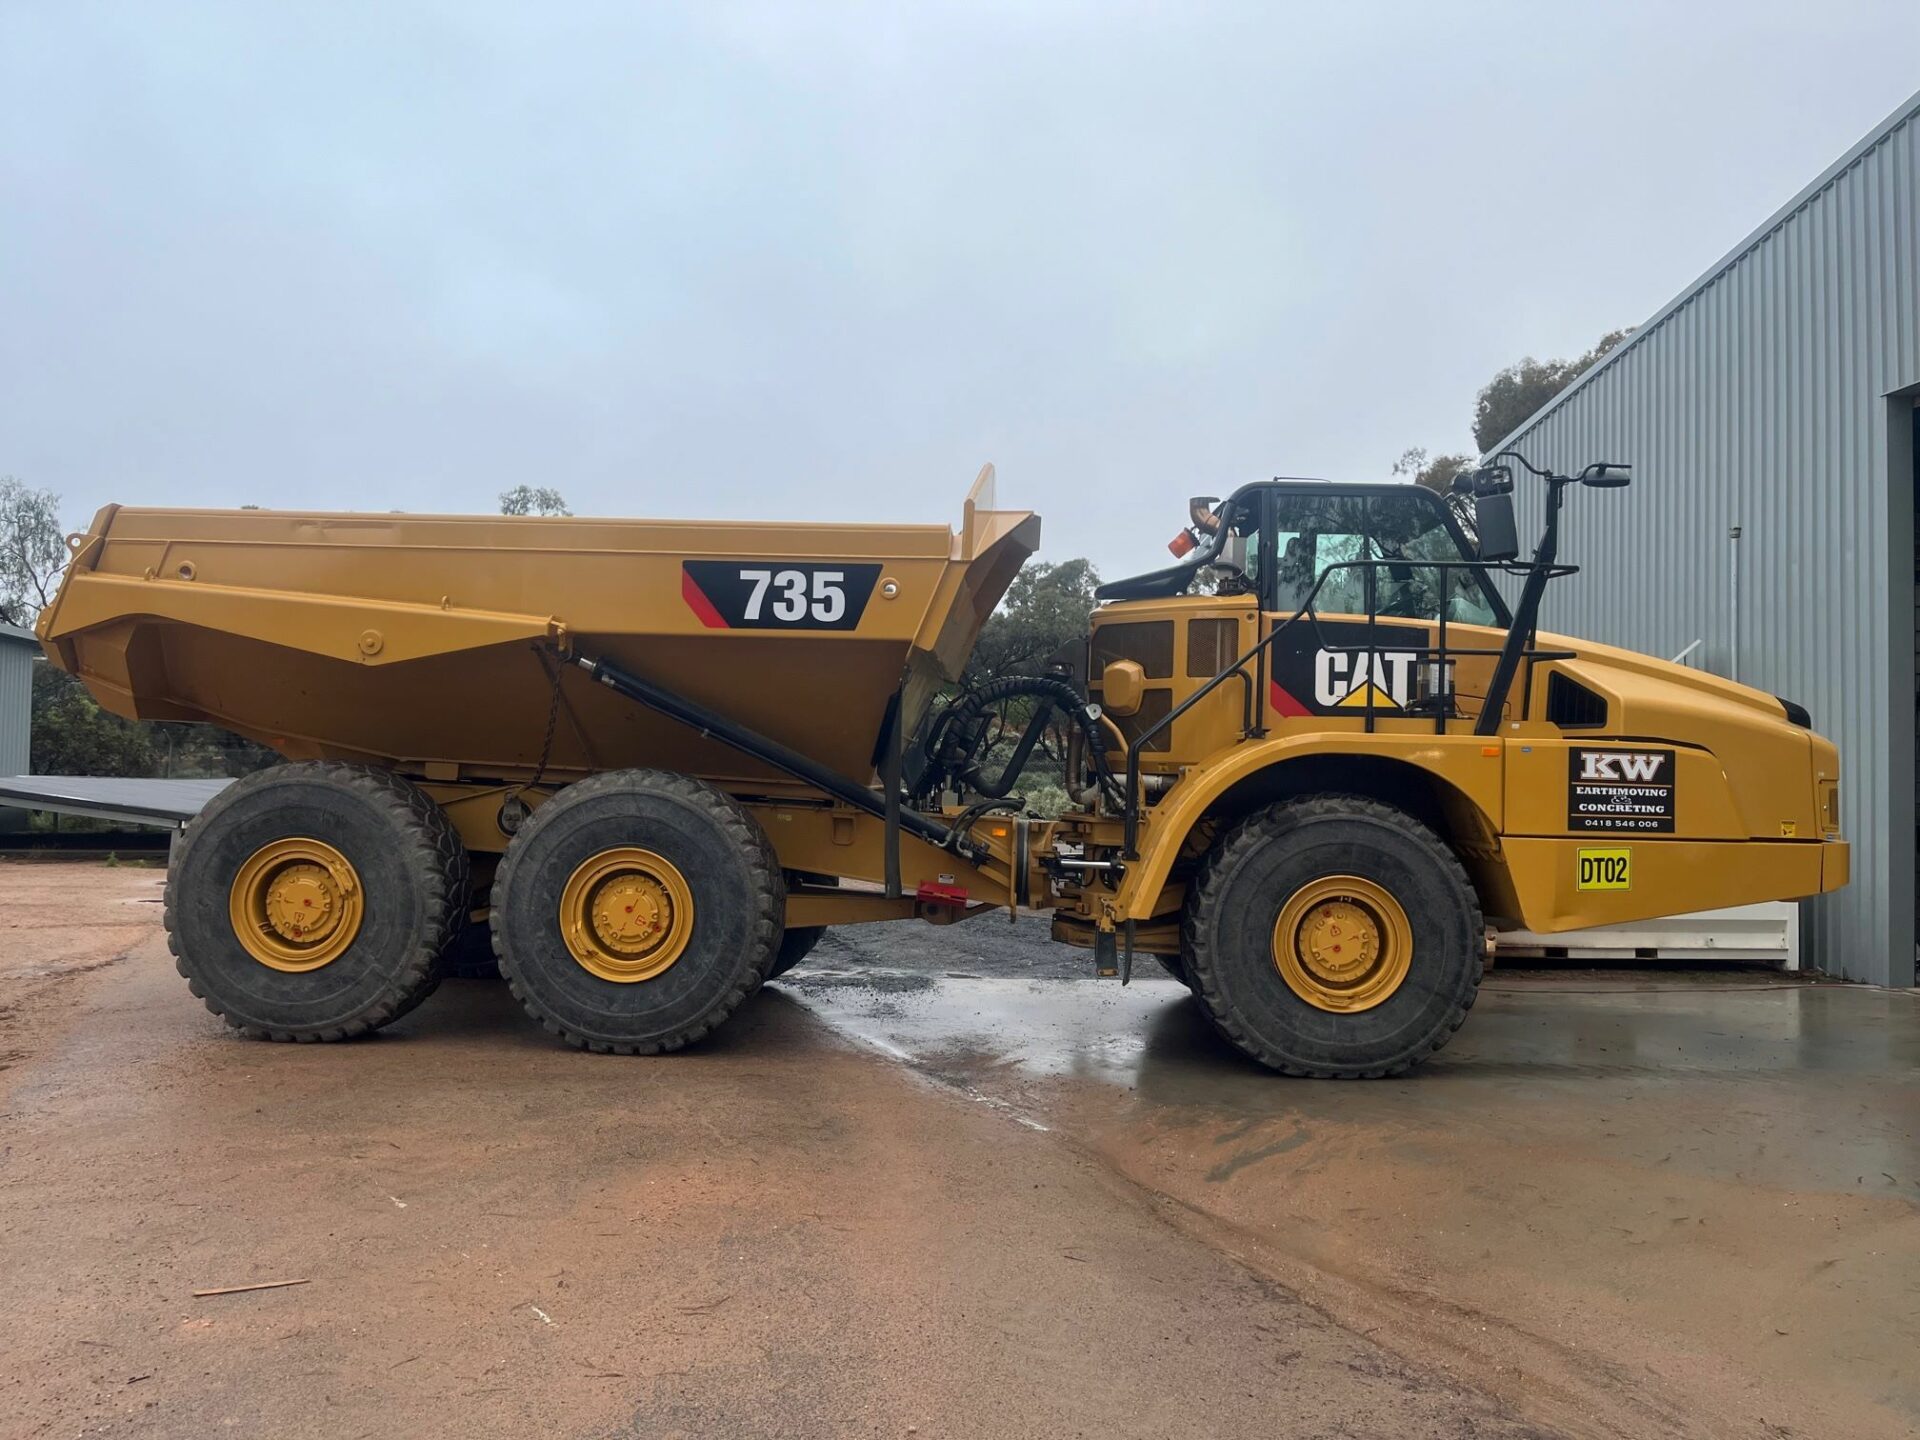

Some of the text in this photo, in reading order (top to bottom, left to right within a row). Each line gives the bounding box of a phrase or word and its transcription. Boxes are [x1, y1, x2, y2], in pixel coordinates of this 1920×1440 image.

[740, 569, 846, 622] 735
[1315, 649, 1417, 711] CAT
[1581, 752, 1665, 781] KW
[1576, 786, 1668, 797] EARTHMOVING
[1579, 803, 1665, 813] CONCRETING
[1585, 819, 1658, 828] 0418 546 006
